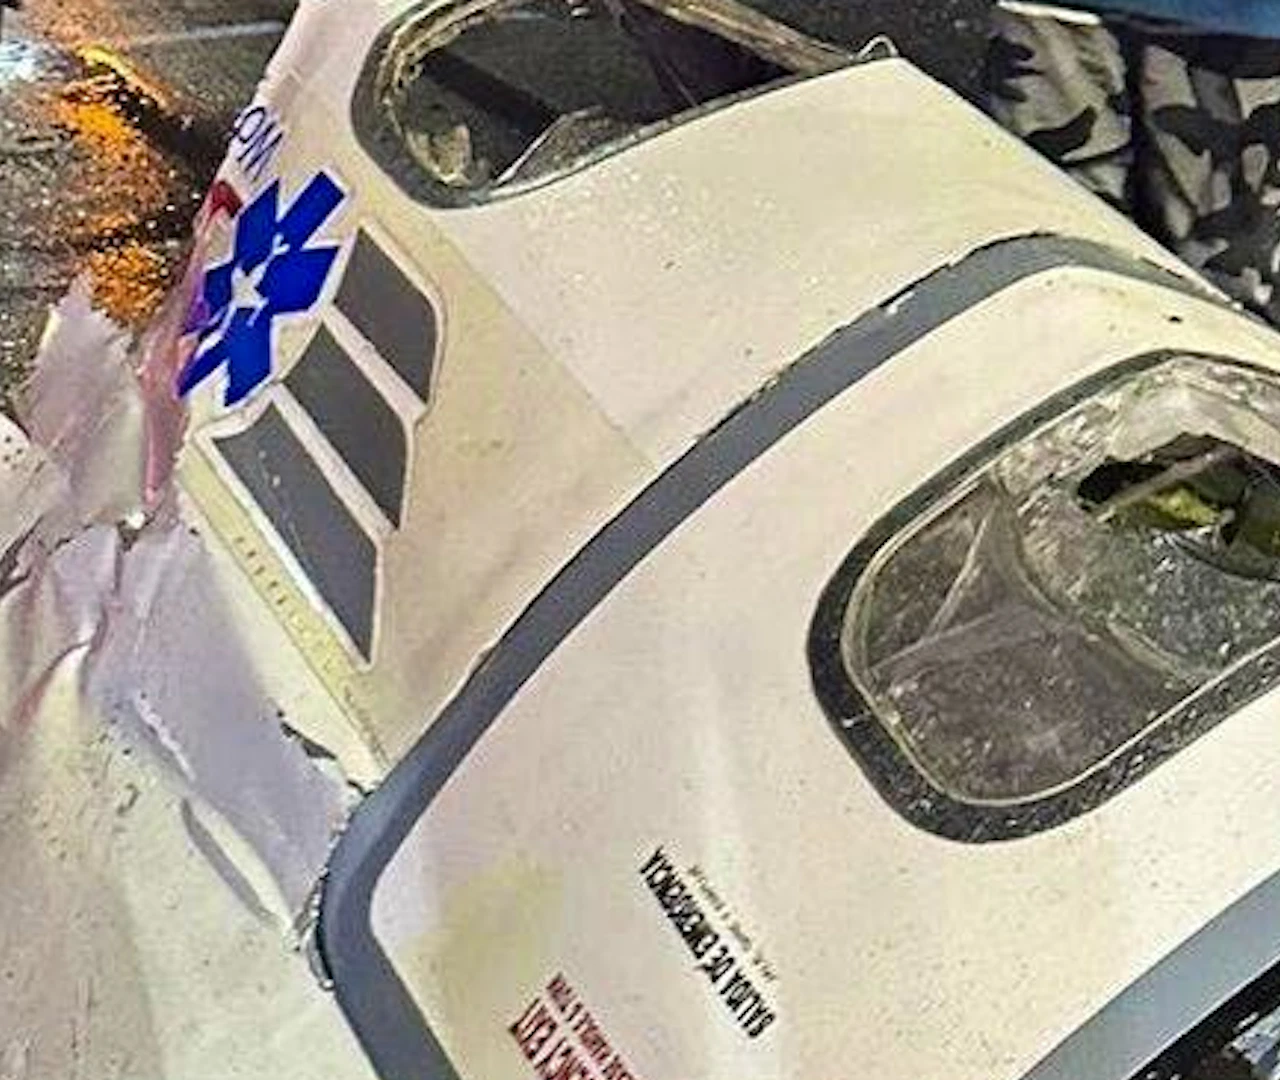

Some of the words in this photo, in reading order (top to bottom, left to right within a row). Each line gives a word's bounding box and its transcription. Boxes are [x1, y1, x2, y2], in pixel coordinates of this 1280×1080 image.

[638, 846, 719, 960] EMERGENCIA
[700, 944, 735, 983] DE
[507, 998, 558, 1060] EXIT
[717, 968, 776, 1039] SALIDA
